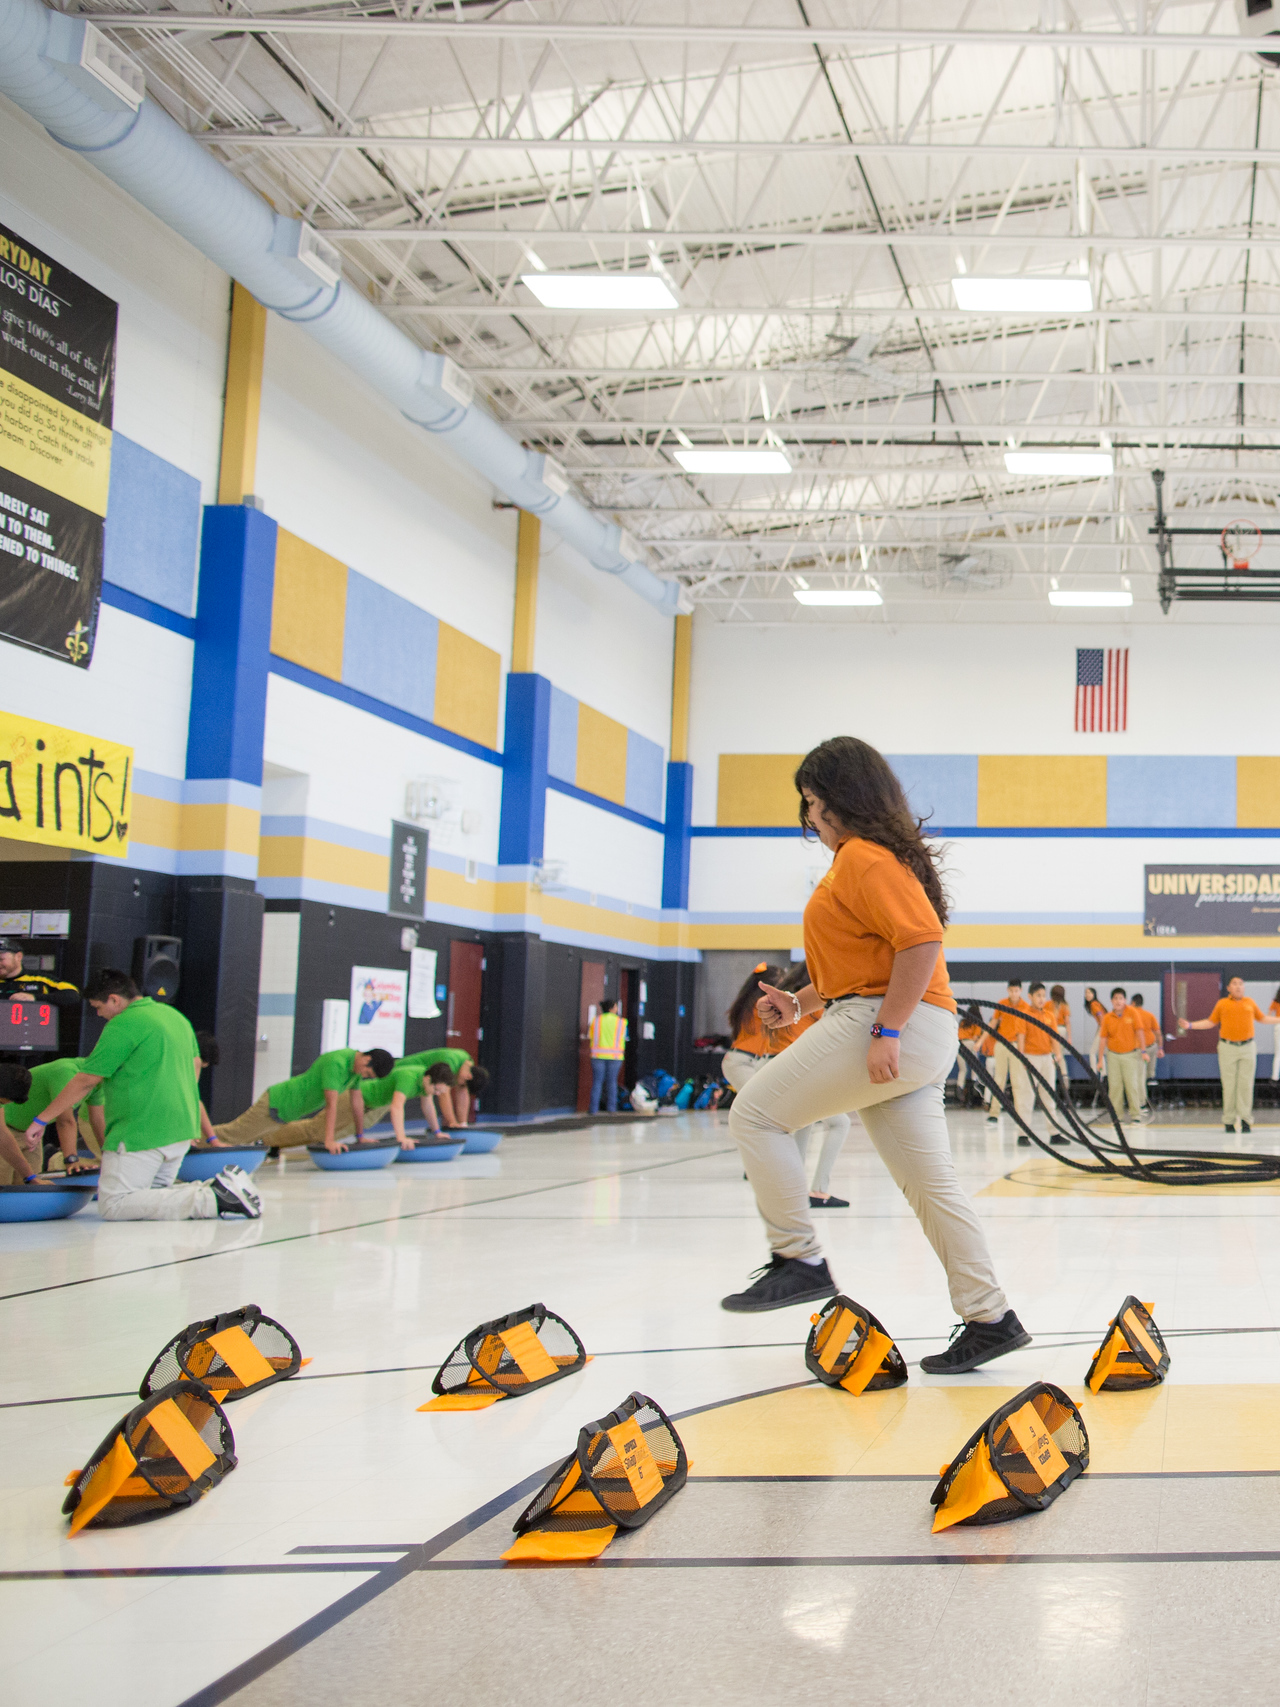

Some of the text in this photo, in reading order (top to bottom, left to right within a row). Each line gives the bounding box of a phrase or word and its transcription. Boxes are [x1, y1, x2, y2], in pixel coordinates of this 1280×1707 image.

[0, 266, 60, 318] LOS DÍAS
[1, 330, 28, 354] work
[29, 346, 48, 365] out
[48, 355, 60, 373] in
[60, 363, 77, 383] the
[2, 308, 98, 376] give 100% all of the
[7, 381, 59, 419] disappointed
[60, 409, 70, 427] by
[72, 417, 84, 432] the
[18, 403, 32, 419] did
[59, 425, 80, 444] throw
[37, 428, 60, 449] Catch
[61, 442, 74, 457] the
[8, 516, 23, 536] TO
[23, 523, 56, 552] THEM.
[30, 507, 51, 528] SAT
[26, 545, 40, 565] TO
[41, 552, 80, 582] THINGS.
